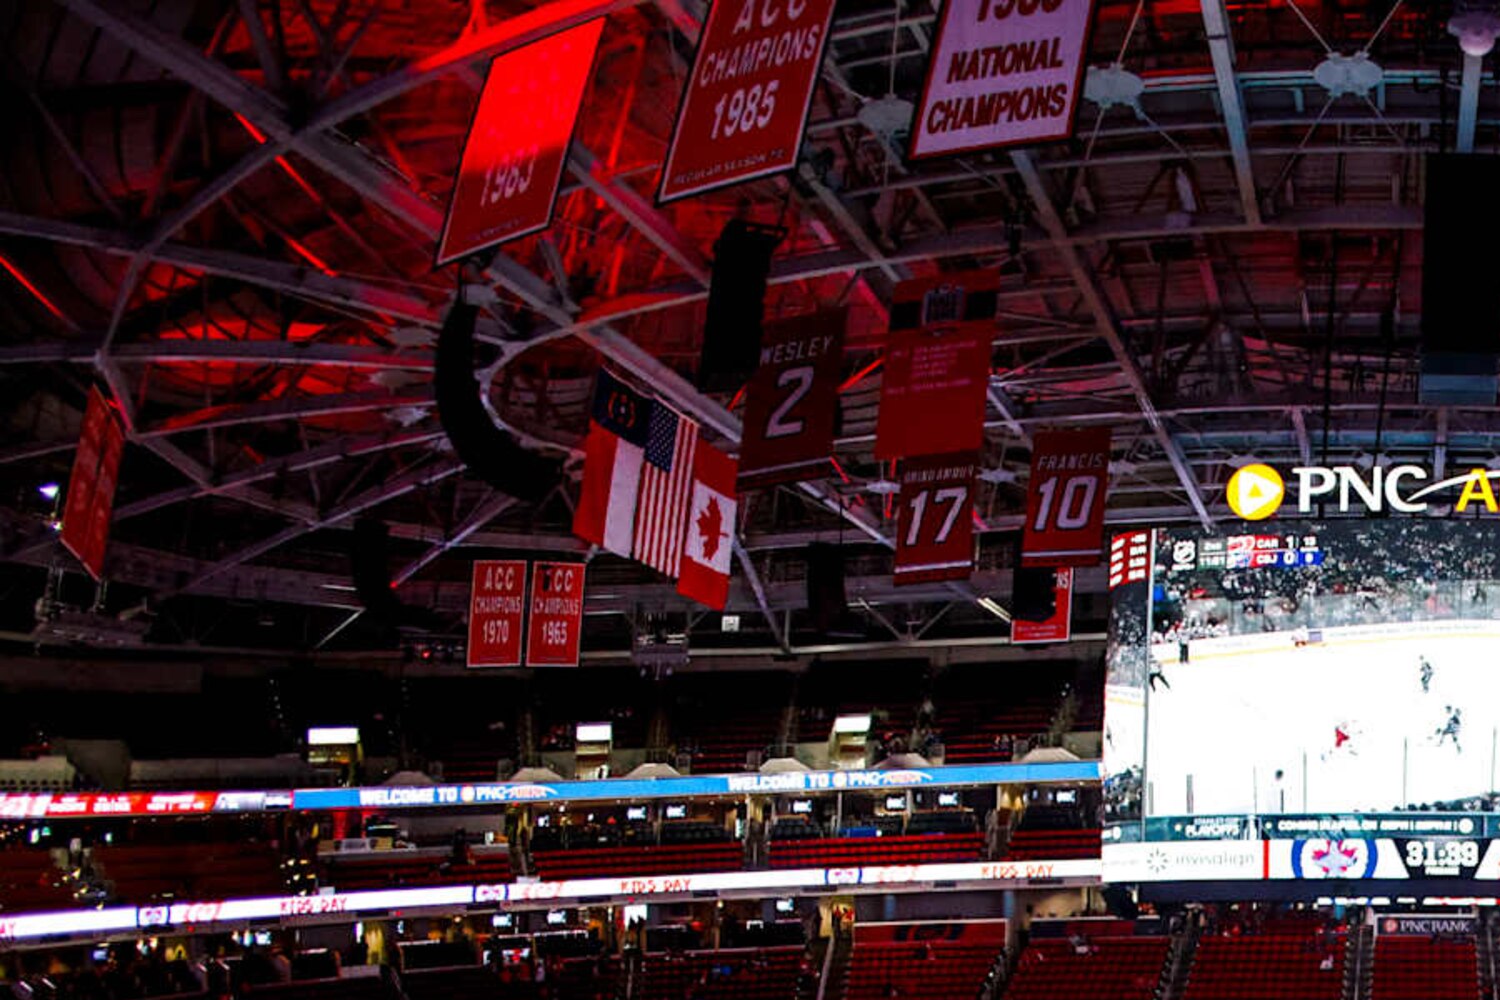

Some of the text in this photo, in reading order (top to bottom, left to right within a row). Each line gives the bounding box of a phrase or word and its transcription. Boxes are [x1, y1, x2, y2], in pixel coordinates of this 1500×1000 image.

[701, 24, 820, 88] CHAMPIONS
[946, 37, 1063, 84] NATIONAL
[711, 80, 779, 140] 1985
[926, 83, 1067, 134] CHAMPIONS
[760, 335, 833, 365] WESLEY
[765, 366, 815, 438] 2
[1037, 453, 1103, 472] FRANCIS
[1034, 475, 1098, 531] 10
[1292, 465, 1427, 513] PNC
[906, 486, 968, 546] 17
[484, 566, 515, 591] ACC
[546, 569, 574, 591] CC
[483, 620, 510, 644] 1970
[360, 787, 434, 806] WELCOME
[437, 786, 458, 802] TO
[475, 785, 507, 801] PNC
[728, 774, 805, 791] WELCOME
[808, 774, 830, 788] TO
[852, 772, 881, 786] PNC
[1026, 864, 1054, 878] DAY
[621, 879, 692, 894] KIDS DAY
